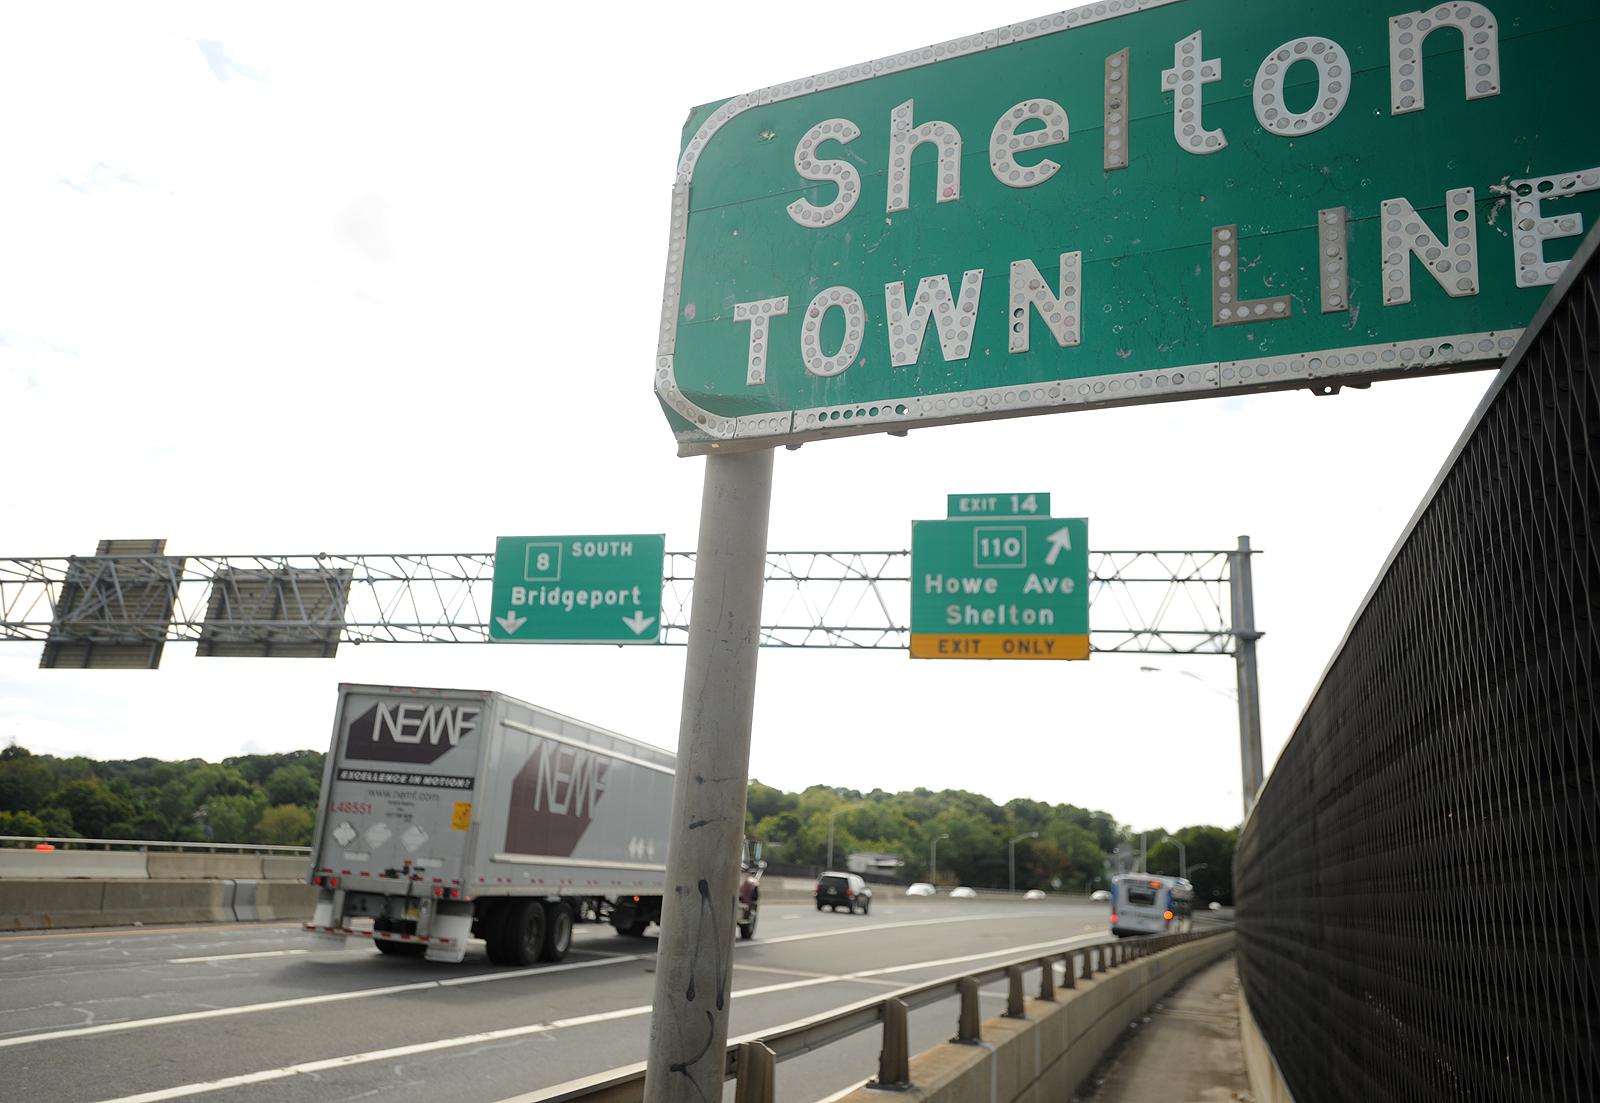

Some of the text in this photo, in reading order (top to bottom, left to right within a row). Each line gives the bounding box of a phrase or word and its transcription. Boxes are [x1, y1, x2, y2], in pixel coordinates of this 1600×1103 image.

[786, 1, 1500, 228] Shelton
[733, 167, 1600, 385] TOWN LINE
[959, 494, 1038, 513] EXIT 14
[536, 541, 633, 571] 8 SOUTH
[980, 536, 1020, 558] 110
[925, 573, 1075, 594] Howe Ave
[511, 585, 641, 612] Bridgeport
[946, 604, 1054, 625] Shelton
[938, 639, 1056, 654] EXIT ONLY
[372, 701, 481, 746] NEMF
[340, 770, 409, 785] EXCELLENCE
[408, 775, 422, 786] IN
